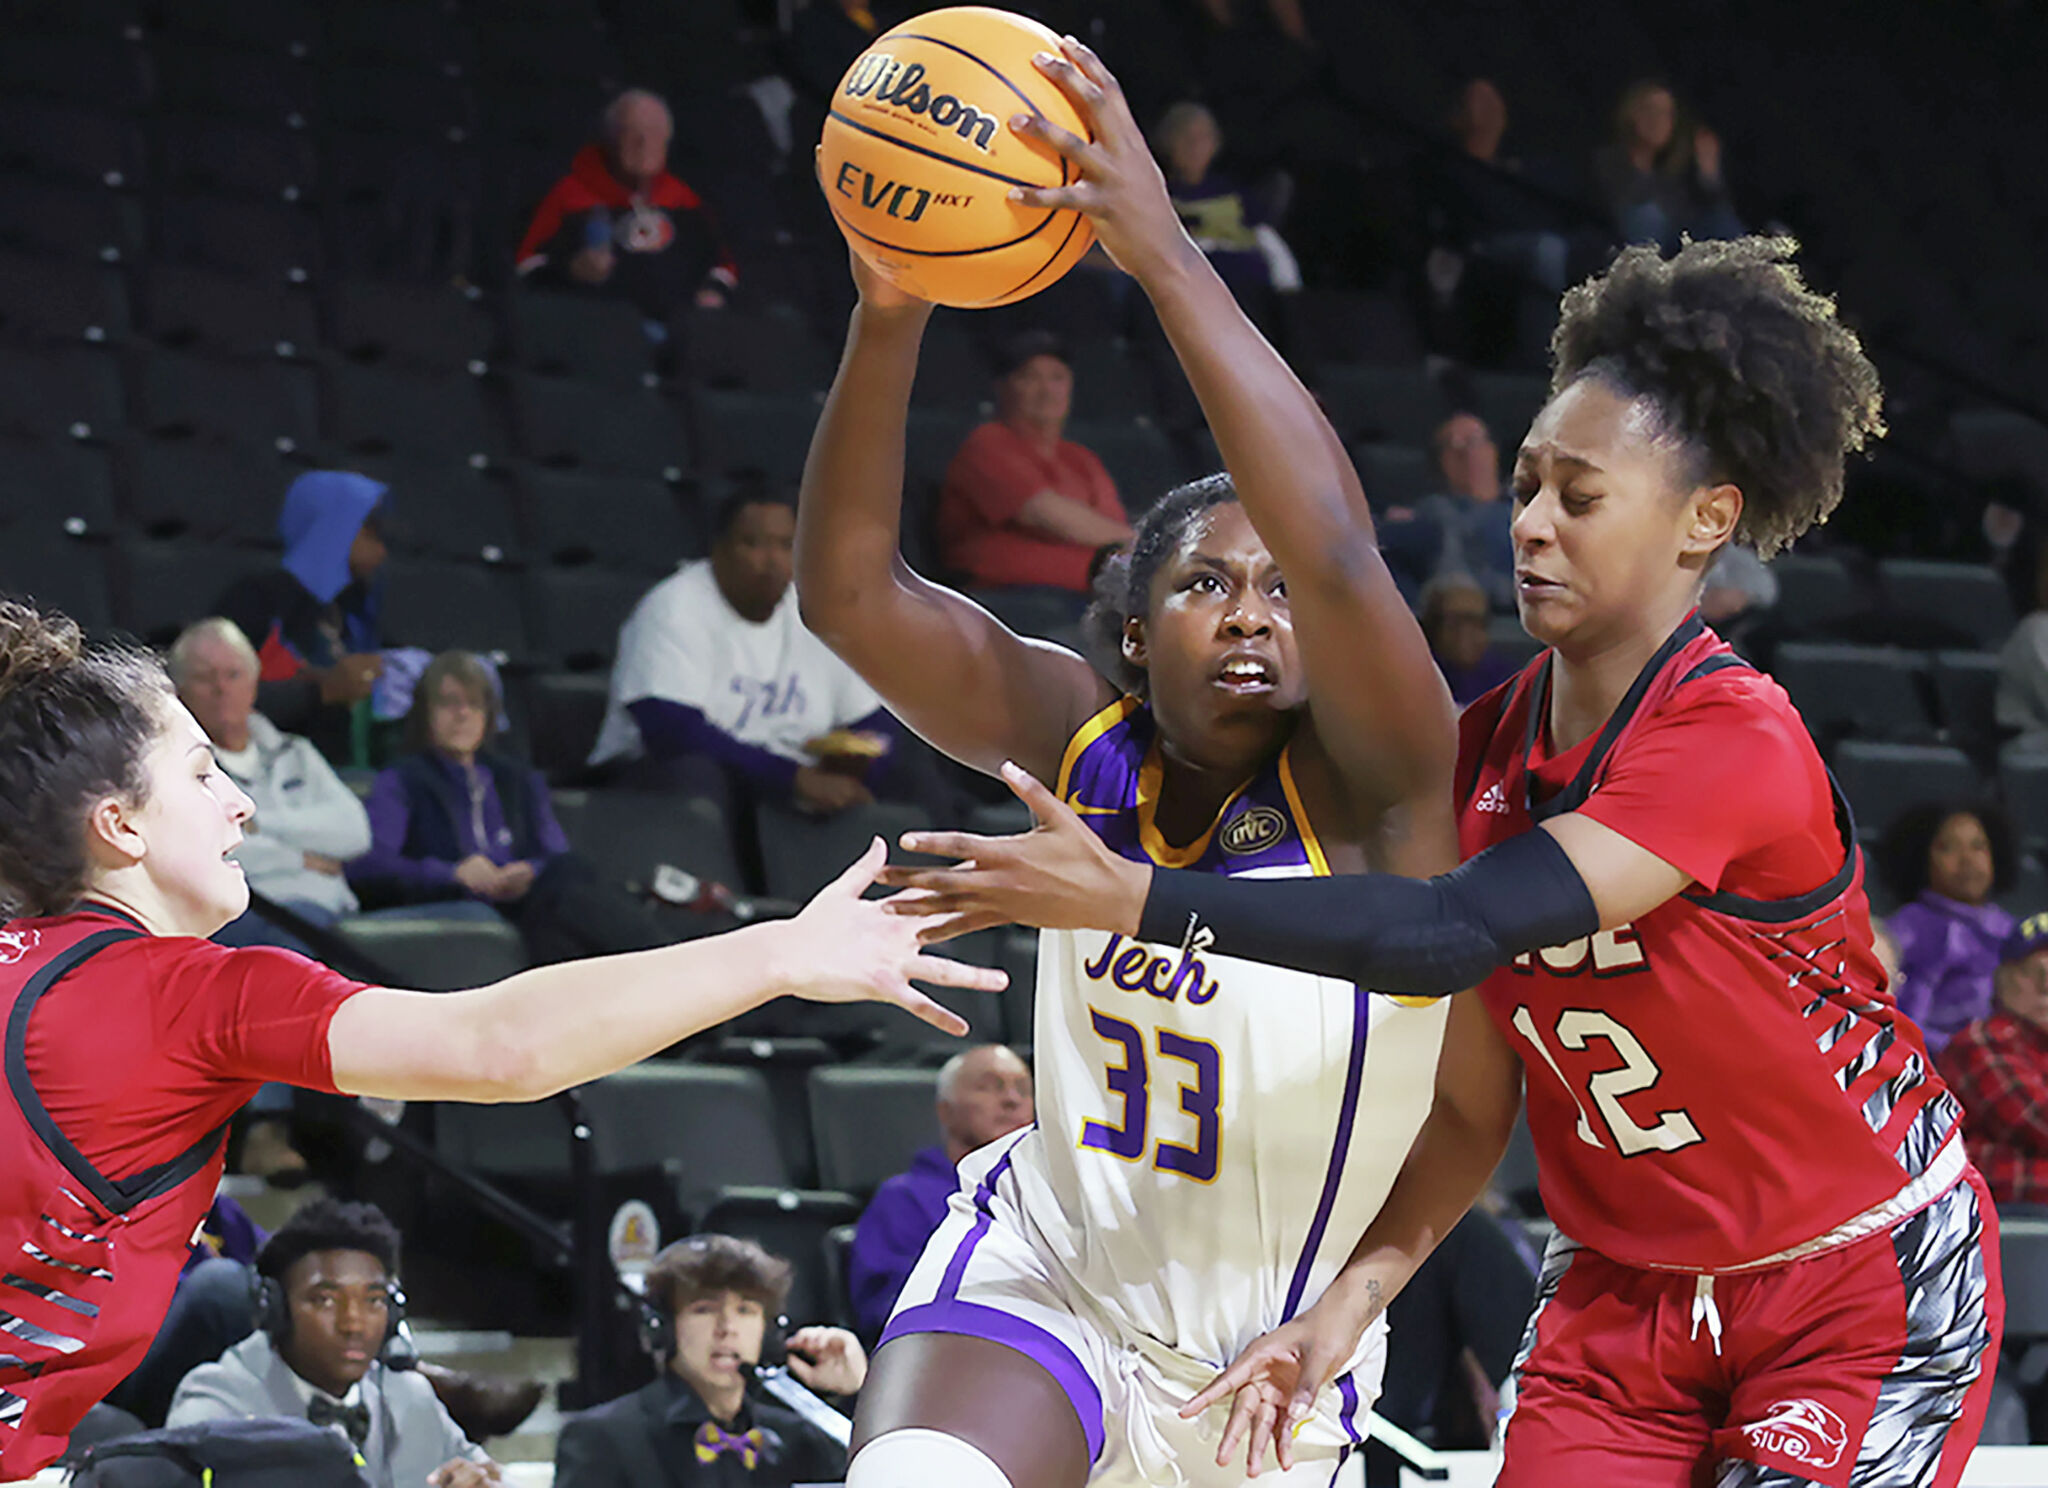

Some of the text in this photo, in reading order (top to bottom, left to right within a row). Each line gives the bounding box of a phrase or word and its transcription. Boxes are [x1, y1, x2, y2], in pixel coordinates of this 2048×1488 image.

[845, 54, 997, 153] Wilson
[933, 193, 975, 208] NXT
[1077, 1004, 1222, 1184] 33
